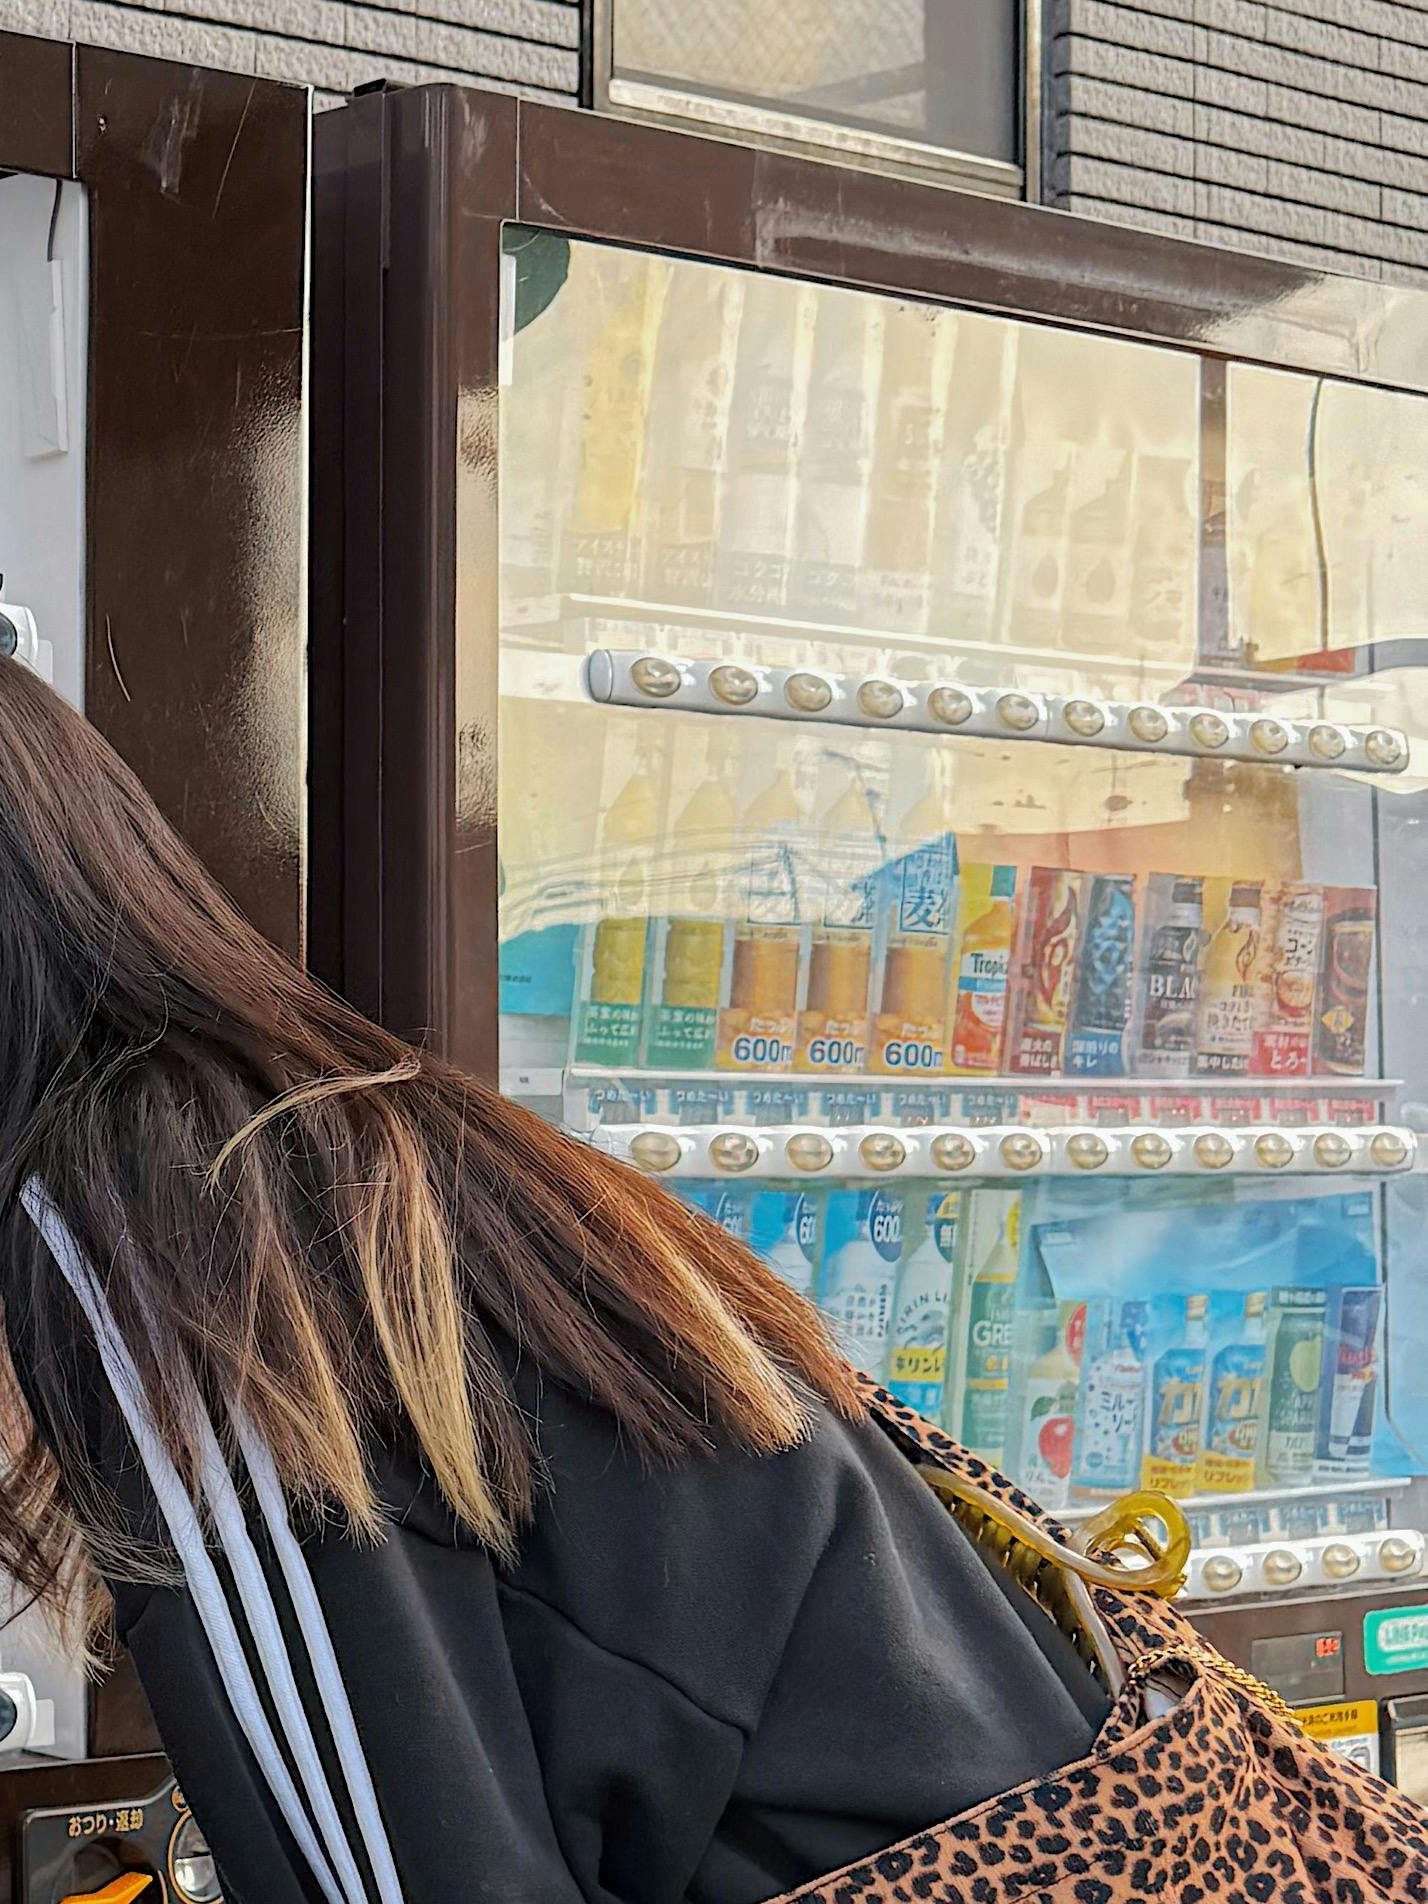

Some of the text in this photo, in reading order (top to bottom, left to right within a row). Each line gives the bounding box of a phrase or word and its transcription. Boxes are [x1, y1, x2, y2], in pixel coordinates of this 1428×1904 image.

[68, 1808, 143, 1838] おつり・返却
